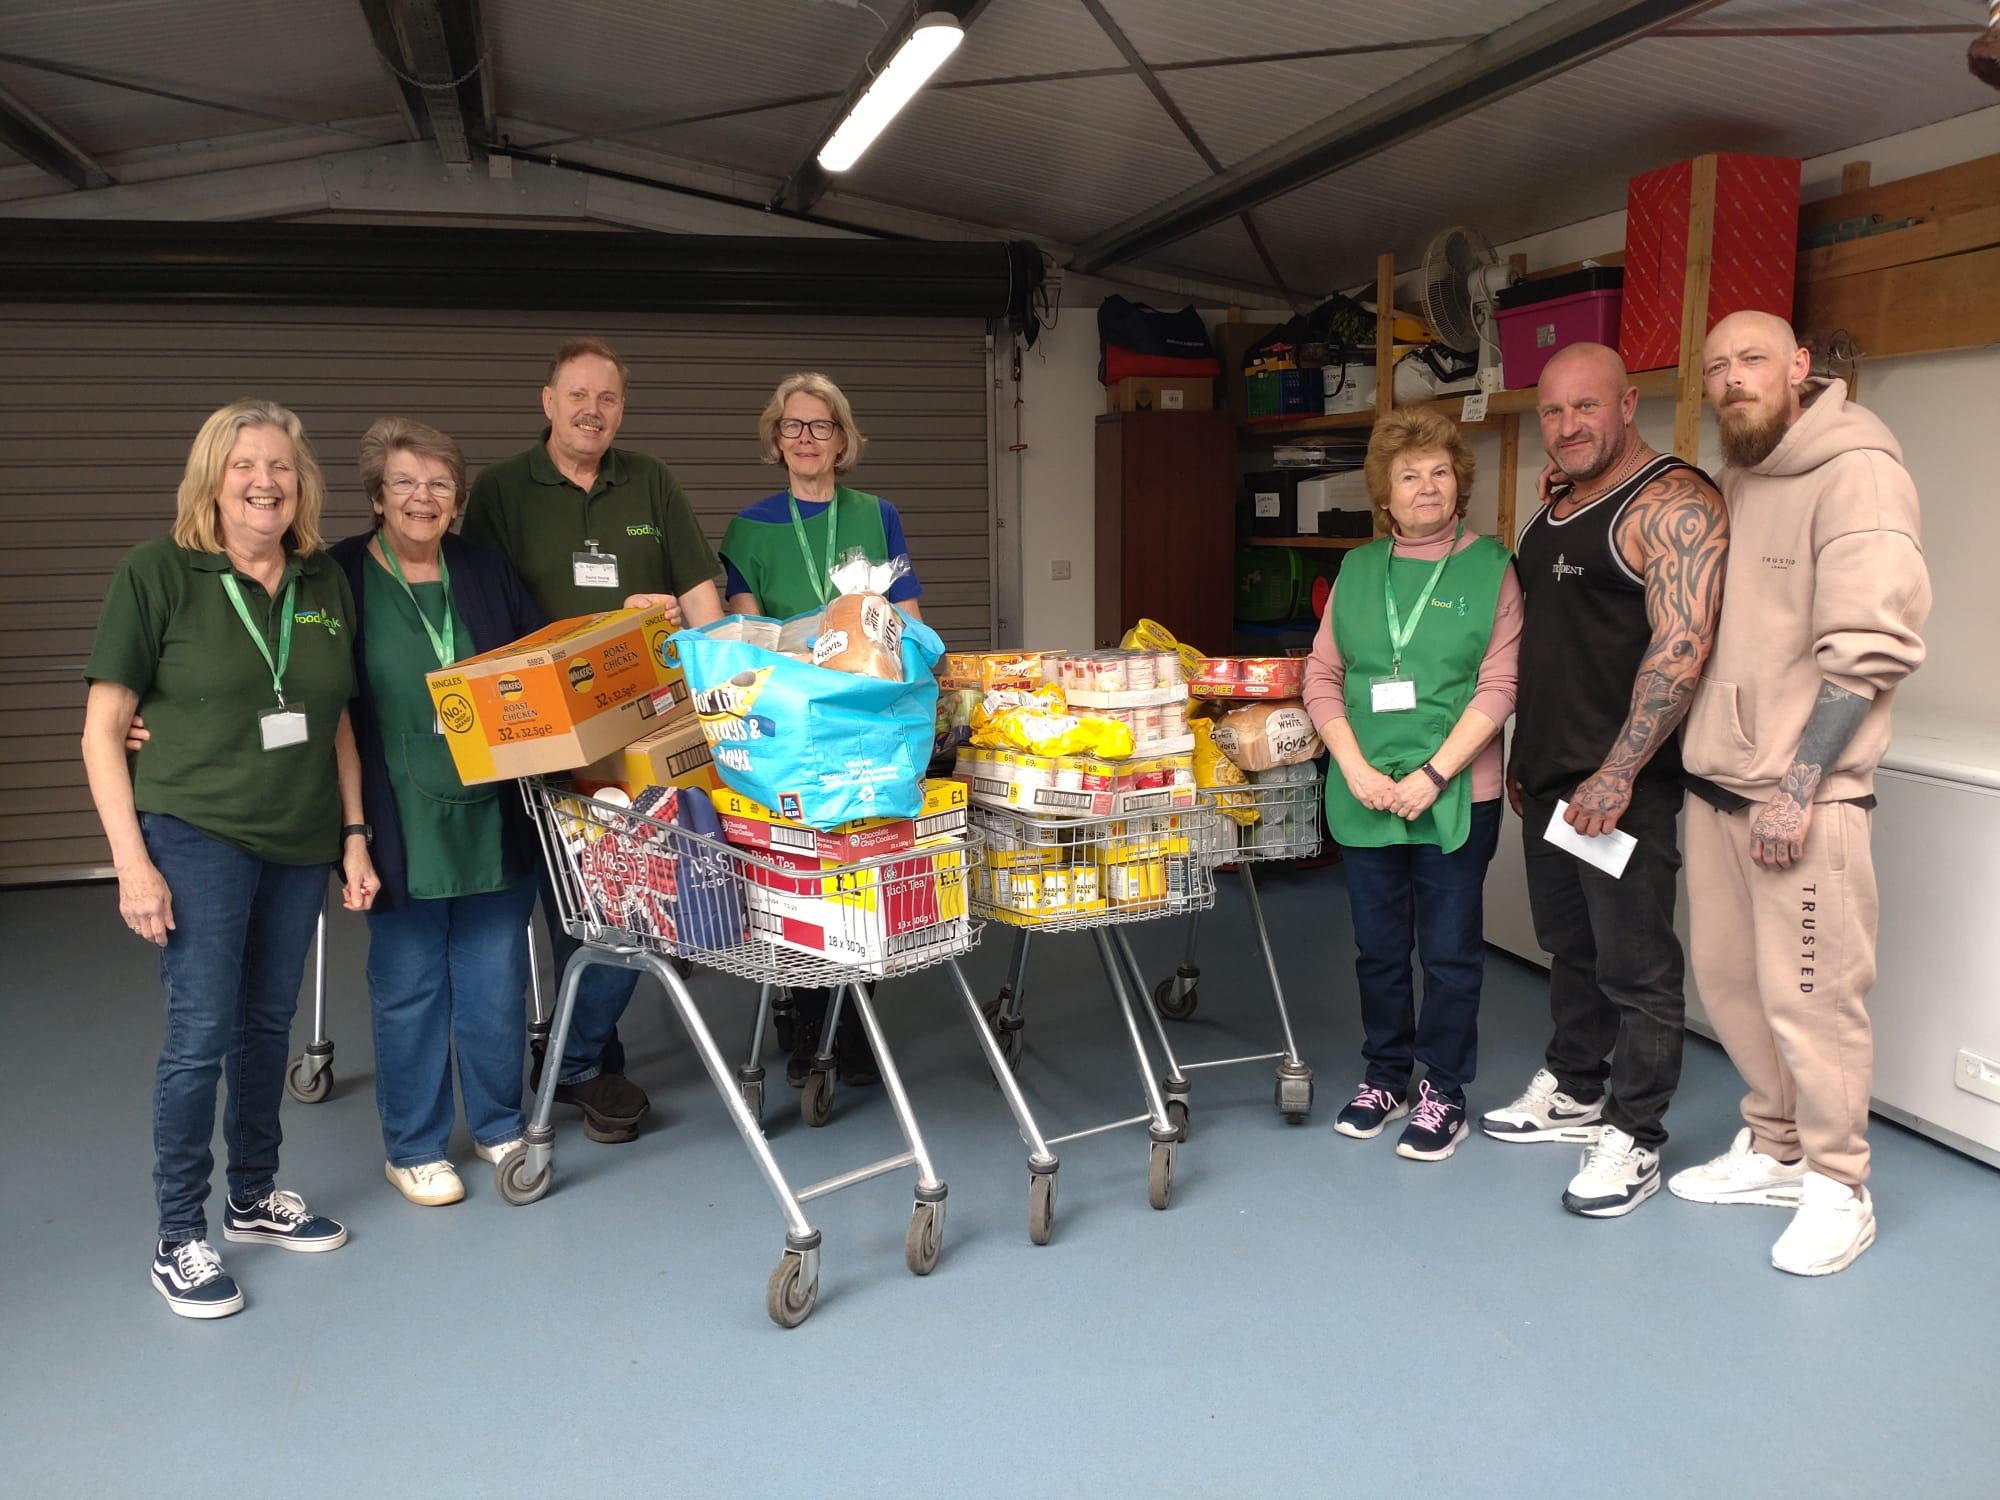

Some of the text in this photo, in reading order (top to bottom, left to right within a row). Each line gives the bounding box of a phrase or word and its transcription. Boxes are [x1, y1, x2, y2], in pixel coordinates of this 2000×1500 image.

[644, 614, 667, 628] SINGLE
[885, 618, 897, 652] OVIS
[603, 641, 629, 659] ROAST
[816, 641, 843, 659] HOVIS
[602, 651, 639, 672] CHICKEN
[569, 665, 595, 682] WALKERS
[431, 676, 462, 690] SINGLES
[497, 680, 523, 693] WALKERS
[503, 701, 529, 713] ROAST
[594, 691, 609, 709] 32
[502, 709, 539, 722] CHICKEN
[749, 718, 761, 740] &
[1278, 718, 1303, 730] WHITE
[497, 726, 515, 742] 32
[1276, 735, 1308, 755] HOVIS
[730, 798, 742, 812] £1
[951, 789, 965, 805] £1
[860, 833, 899, 848] Chip Cookies
[776, 856, 796, 870] Tea
[886, 879, 925, 897] Rich Tea
[828, 935, 838, 947] 18
[1800, 883, 1817, 994] TRUSTED
